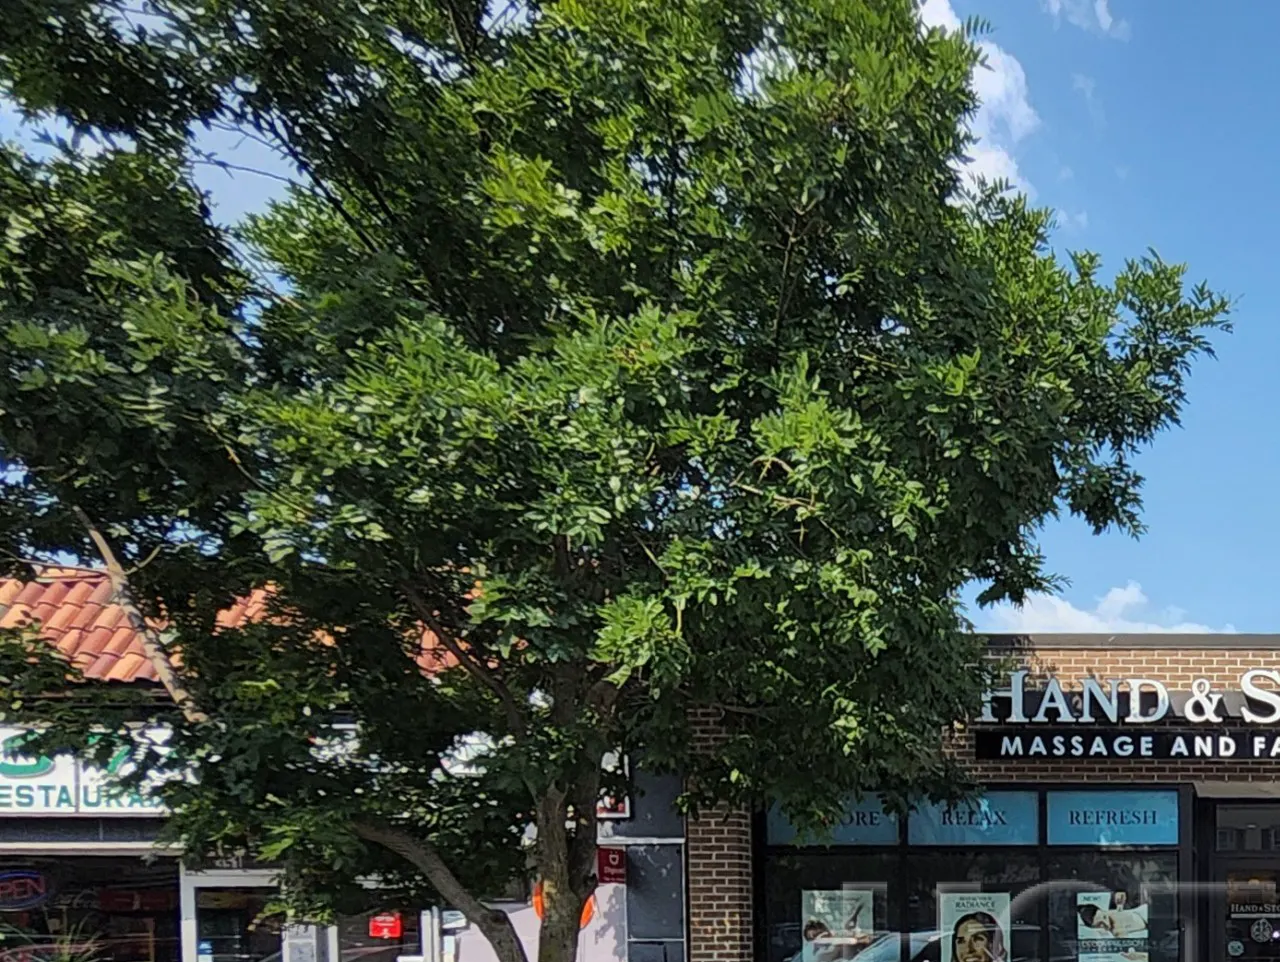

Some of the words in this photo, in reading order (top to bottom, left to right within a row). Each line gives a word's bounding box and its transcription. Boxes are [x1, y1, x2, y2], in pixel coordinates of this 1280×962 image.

[974, 669, 1171, 724] HAND
[1183, 677, 1223, 723] &
[1000, 735, 1153, 757] MASSAGE
[1169, 735, 1237, 757] AND
[941, 810, 1008, 826] RELAX
[1069, 810, 1158, 826] REFRESH
[955, 901, 996, 909] RADIANCE
[1231, 903, 1259, 913] HAND
